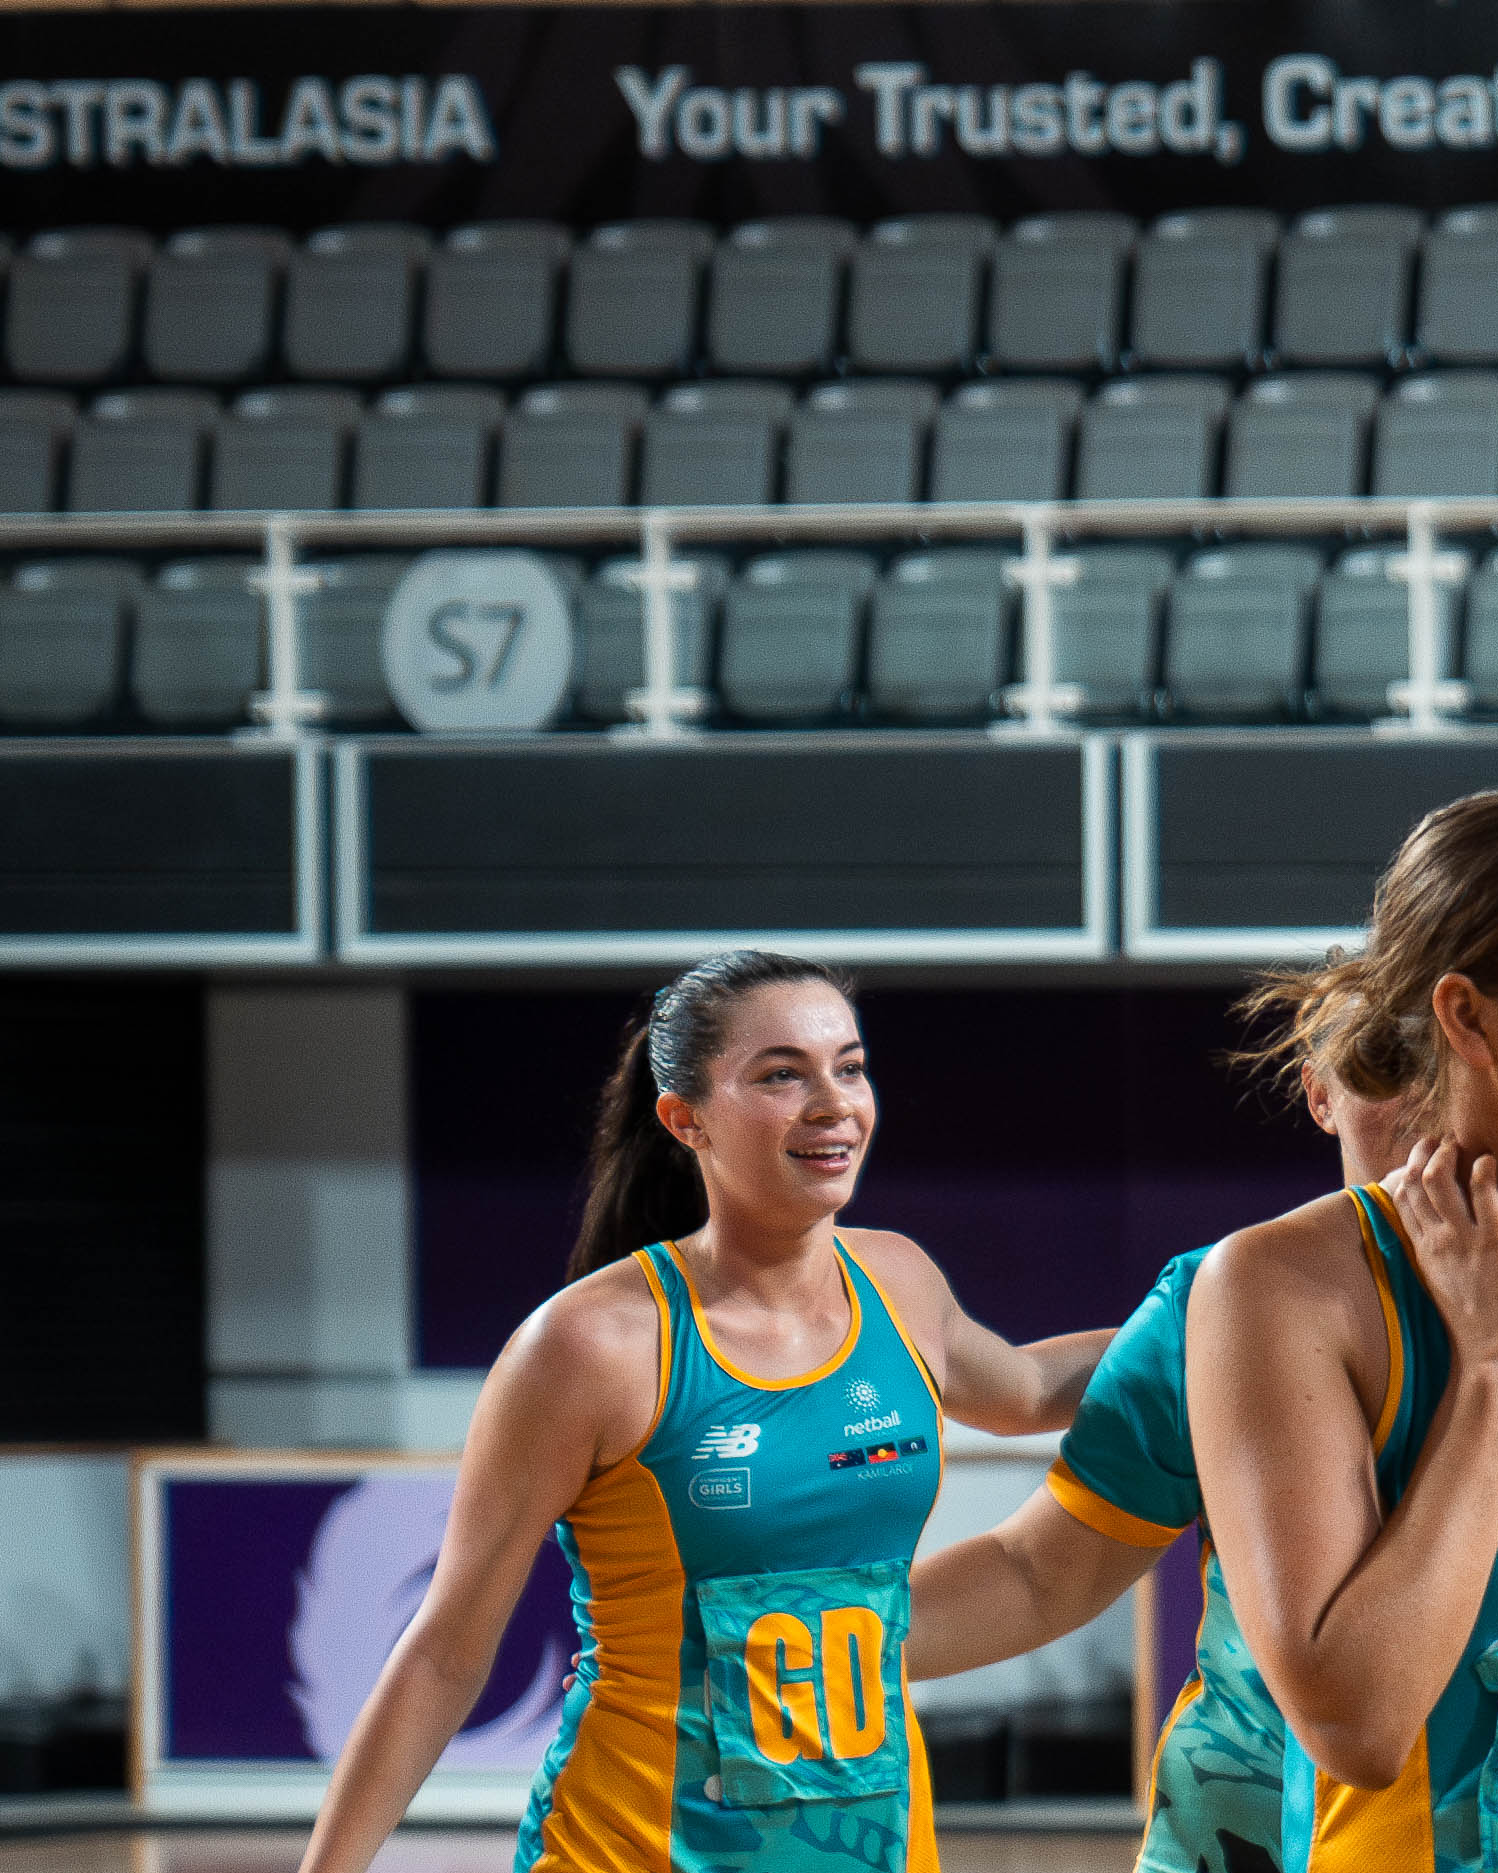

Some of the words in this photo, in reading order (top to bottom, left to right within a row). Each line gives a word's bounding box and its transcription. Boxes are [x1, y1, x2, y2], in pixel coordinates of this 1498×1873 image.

[615, 63, 842, 162] Your
[855, 55, 1243, 164] Trusted,
[426, 600, 526, 694] S7
[843, 1410, 902, 1438] netball
[699, 1483, 743, 1497] GIRLS
[743, 1605, 886, 1766] GD
